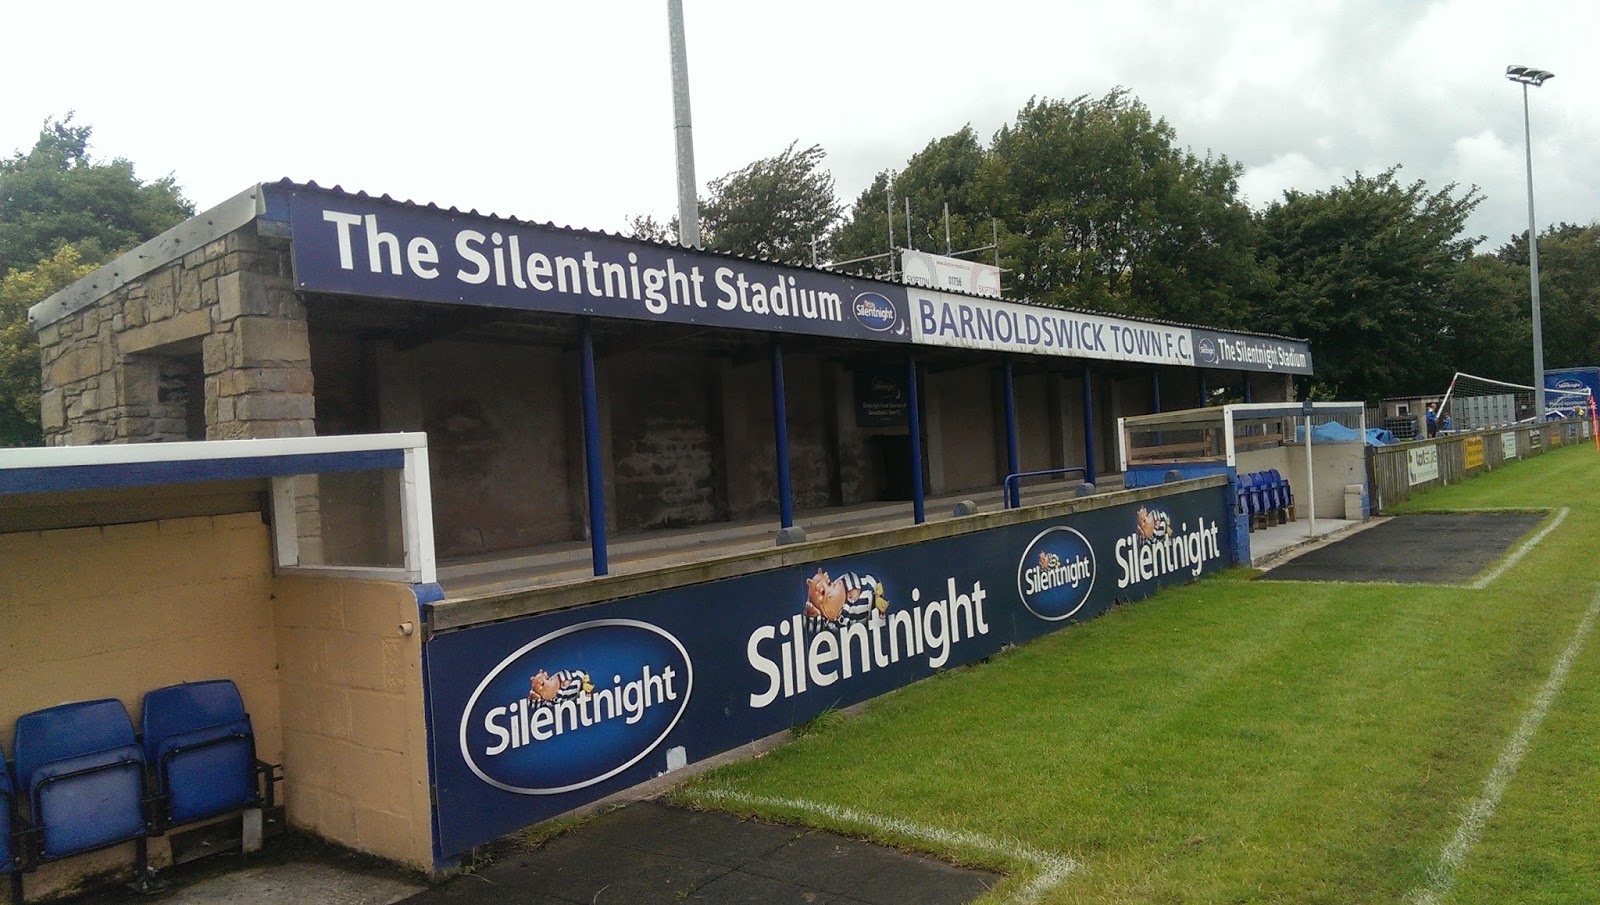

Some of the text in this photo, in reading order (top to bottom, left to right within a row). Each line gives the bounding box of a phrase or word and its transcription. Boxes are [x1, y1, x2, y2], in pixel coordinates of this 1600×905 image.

[323, 210, 842, 321] The Silentnight Stadium
[856, 304, 894, 322] Silentnight
[918, 298, 1192, 360] BARNOLDSWICK TOWN F.C.
[1217, 338, 1307, 369] The Silentnight Stadium
[1025, 555, 1091, 595] Silentnight
[1115, 517, 1220, 589] Silentnight
[748, 576, 989, 708] Silentnight
[485, 665, 677, 756] Silentnight
